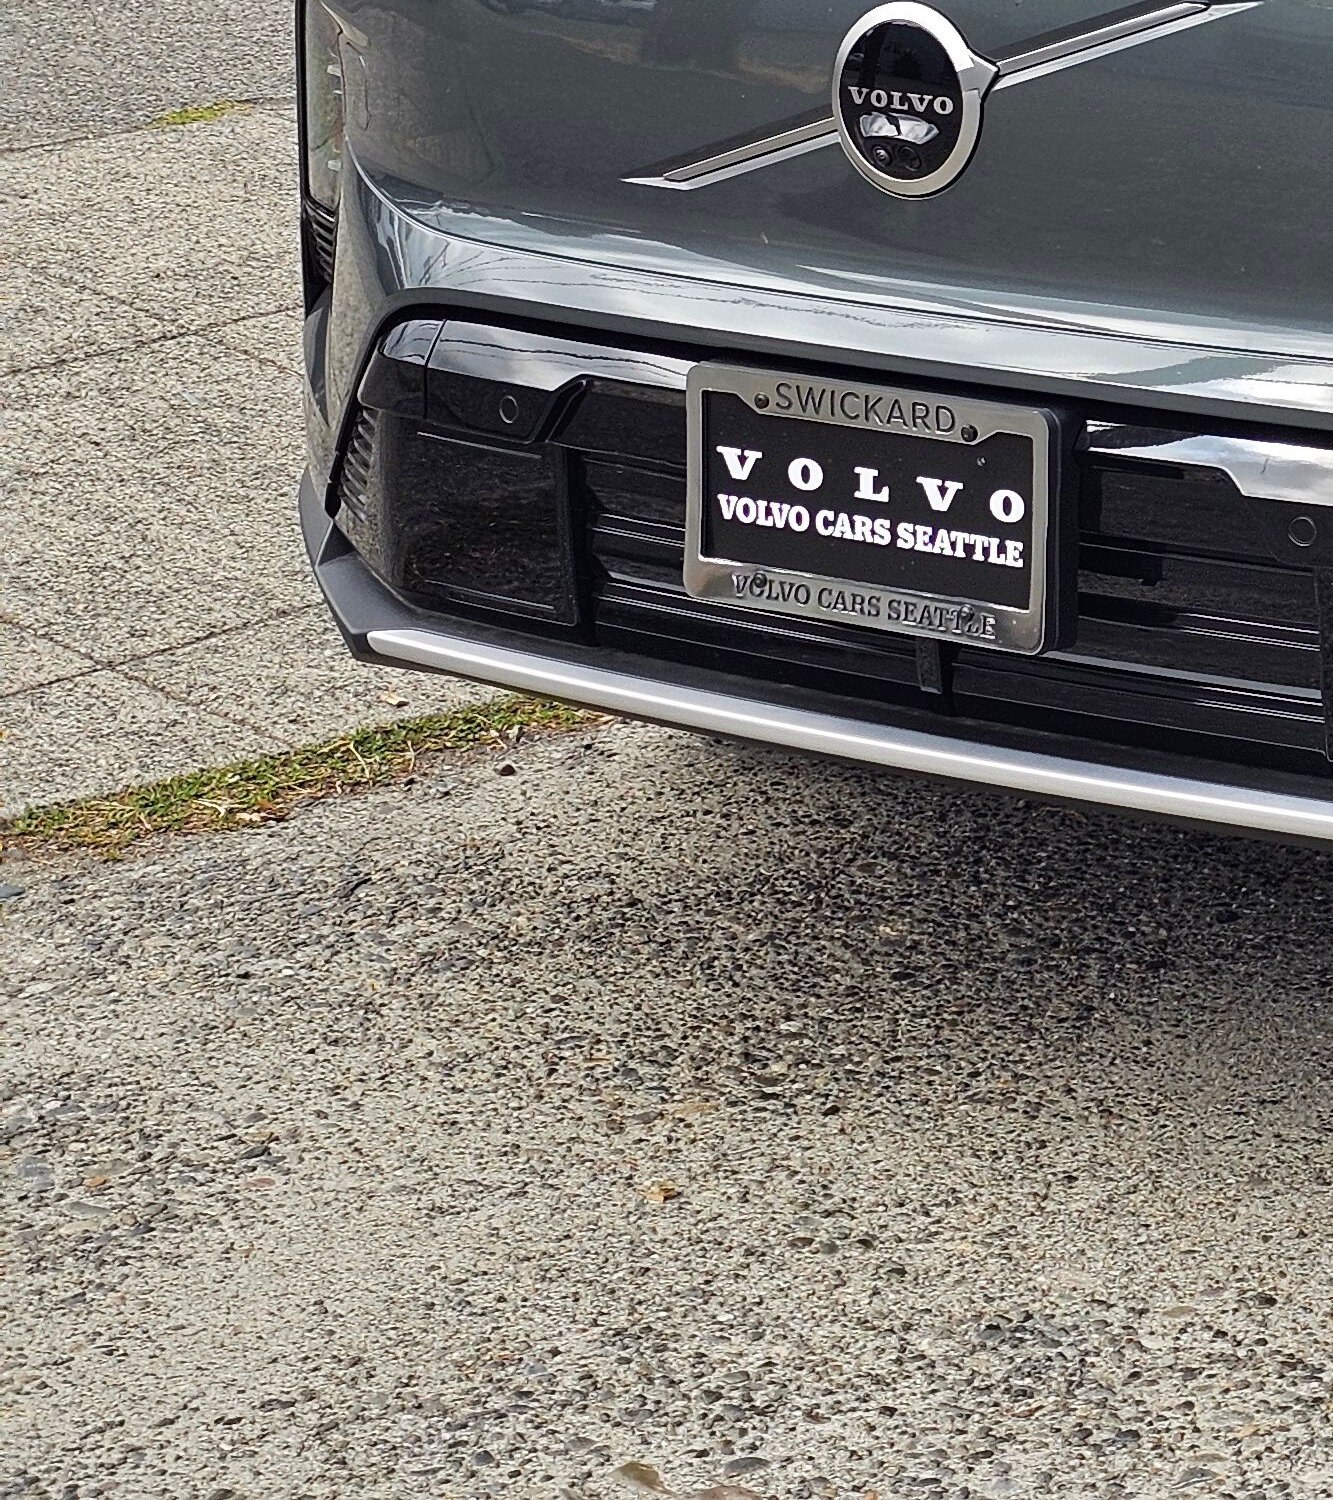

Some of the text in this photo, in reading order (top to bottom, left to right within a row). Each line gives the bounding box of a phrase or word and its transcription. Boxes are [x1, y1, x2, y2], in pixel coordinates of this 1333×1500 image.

[848, 86, 954, 115] VOLVO
[775, 382, 956, 434] SWICKARD
[716, 445, 1026, 523] VOLVO
[717, 493, 1024, 569] VOLVO CARS SEATTLE
[731, 572, 997, 640] VOLVO CARS SEATTLE
